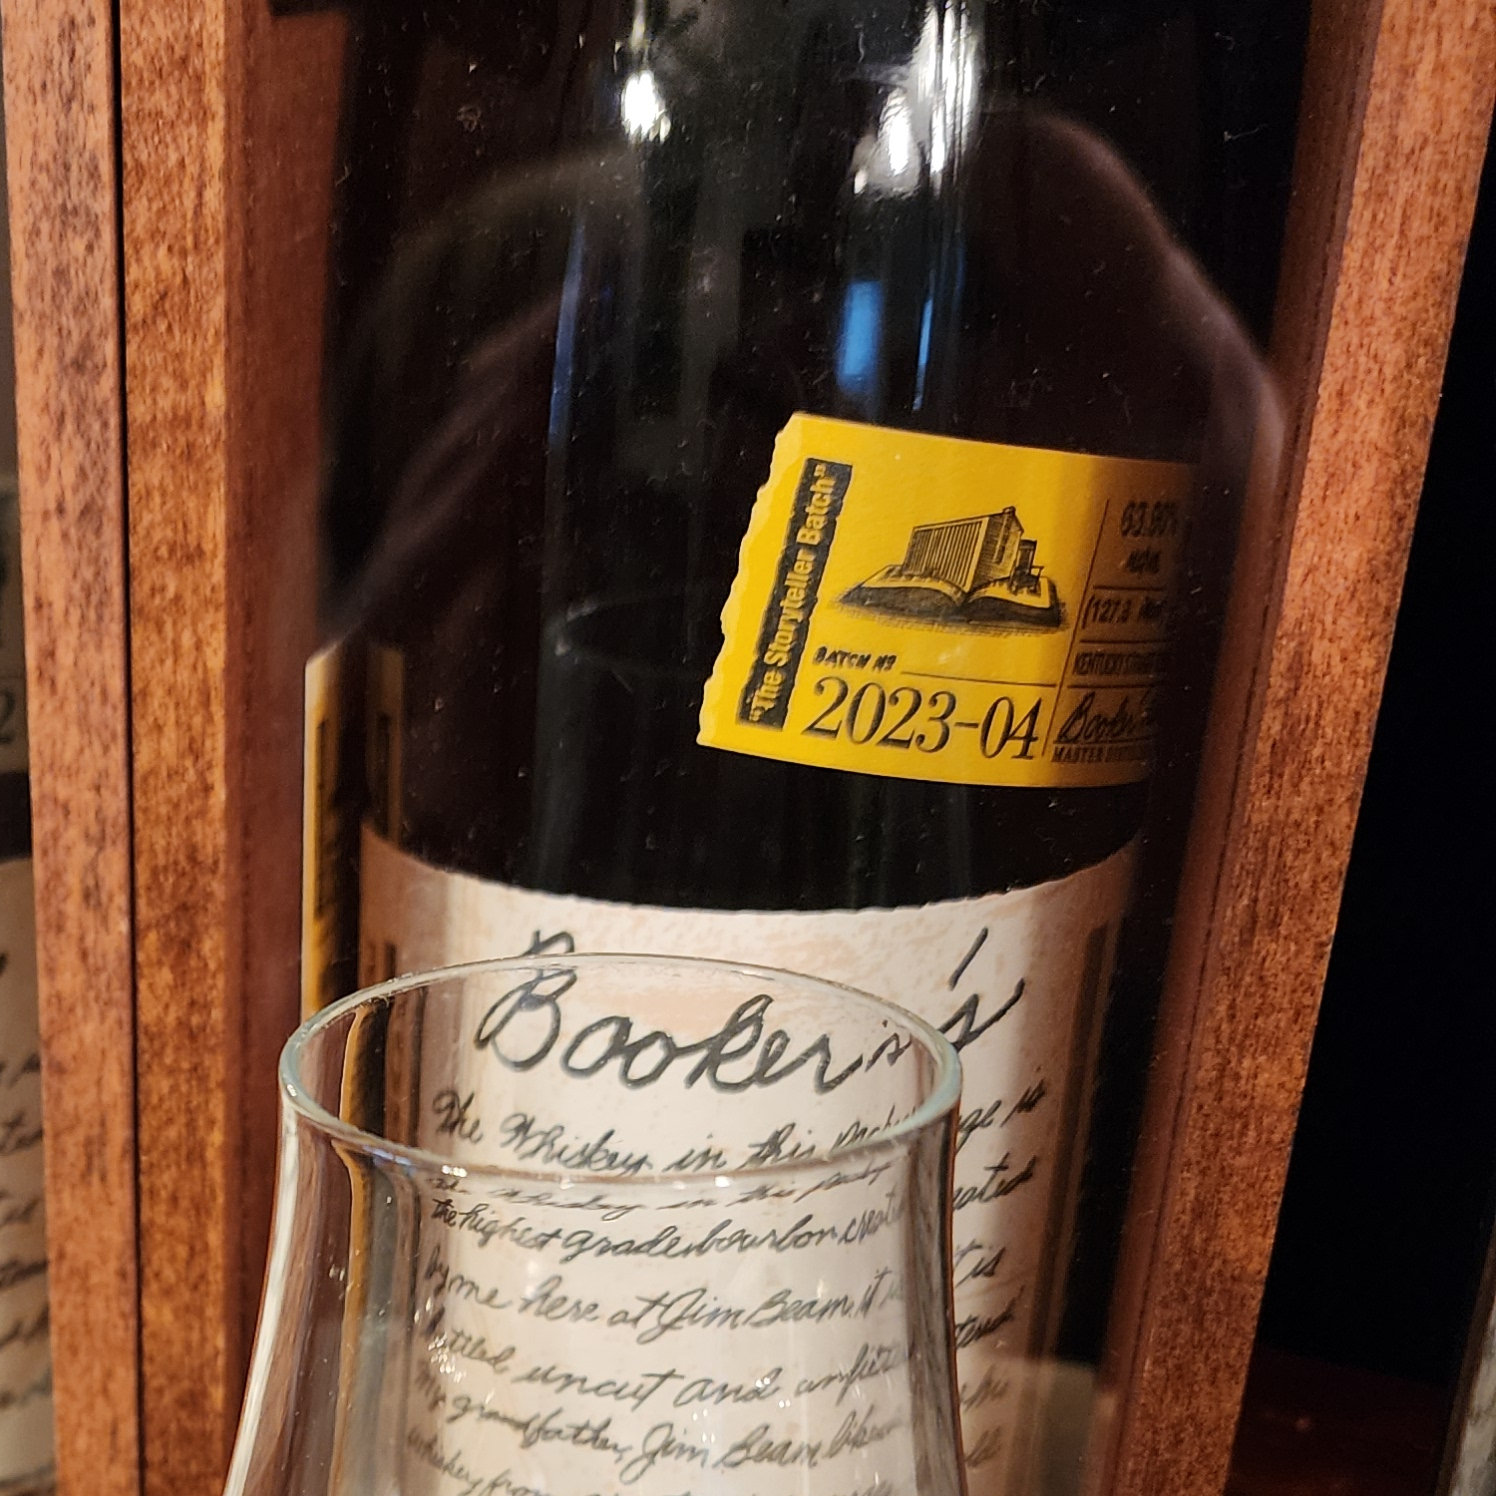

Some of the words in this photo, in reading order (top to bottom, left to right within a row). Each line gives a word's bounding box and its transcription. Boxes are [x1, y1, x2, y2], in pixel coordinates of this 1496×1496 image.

[763, 547, 818, 668] Storyteller
[800, 675, 1043, 761] 2023-04
[473, 927, 1026, 1094] Booker's
[661, 1134, 728, 1173] in
[738, 1121, 816, 1170] this
[455, 1202, 563, 1249] highest
[519, 1273, 600, 1324] here
[607, 1291, 670, 1331] at
[635, 1287, 747, 1345] Jim
[510, 1364, 685, 1412] uncut
[672, 1366, 783, 1408] and
[619, 1421, 710, 1485] Jim
[710, 1423, 824, 1469] Beam
